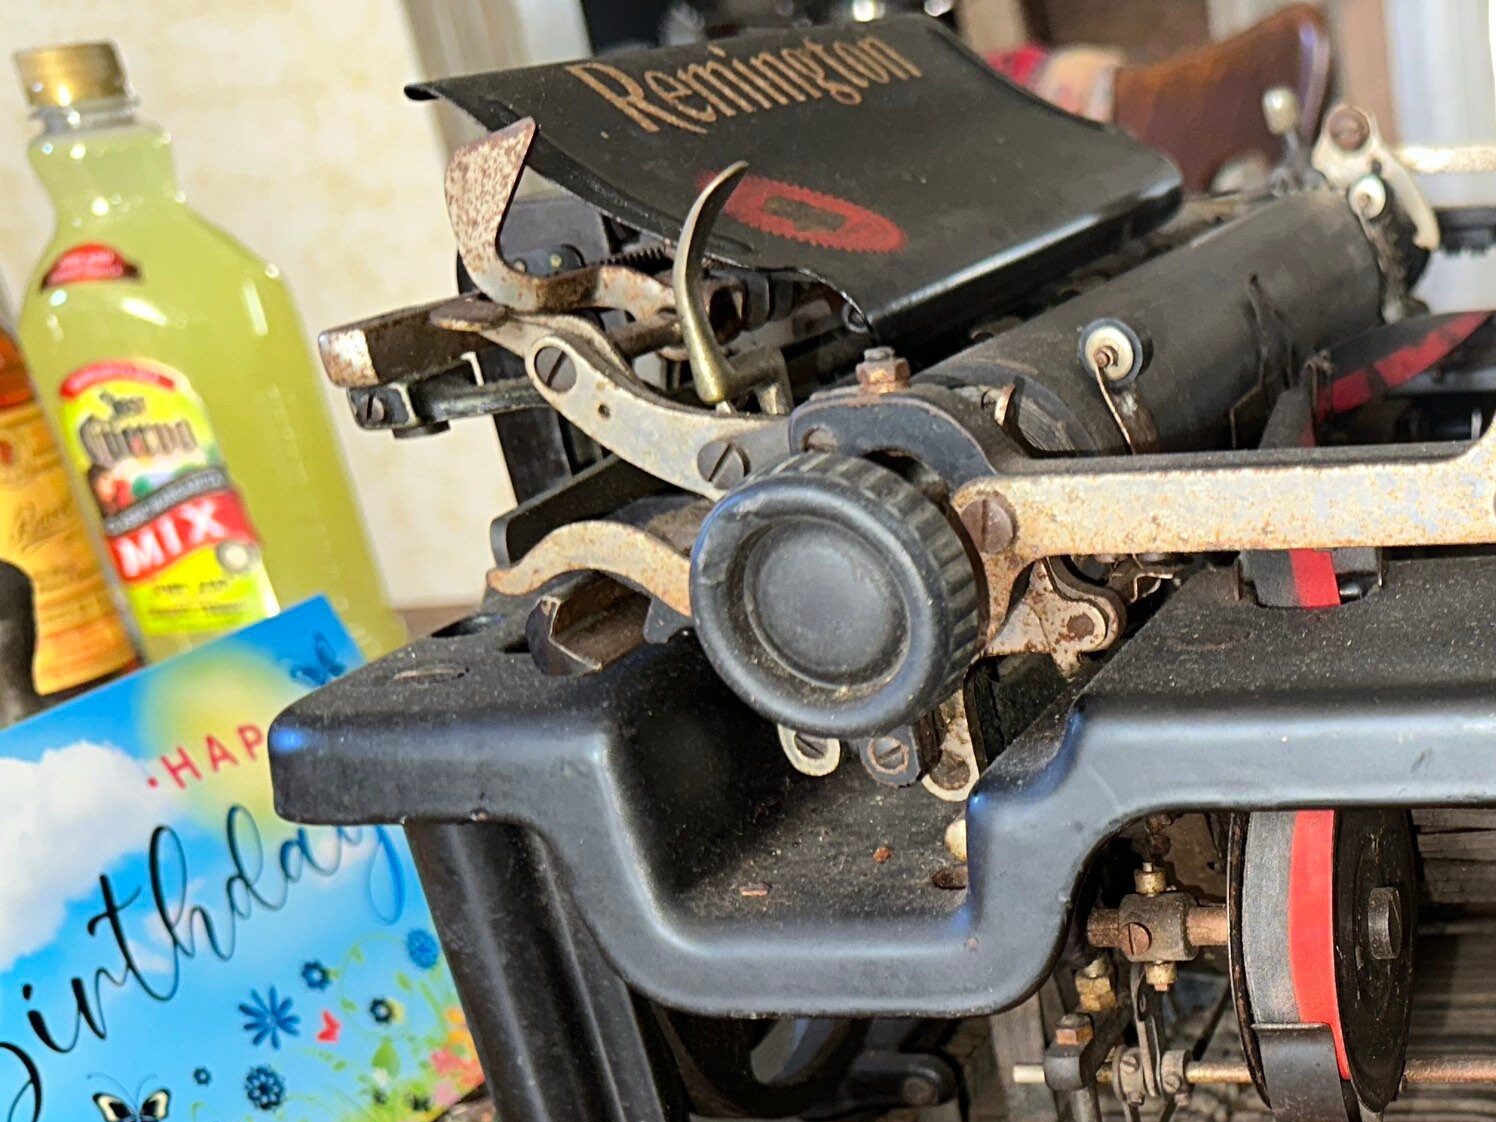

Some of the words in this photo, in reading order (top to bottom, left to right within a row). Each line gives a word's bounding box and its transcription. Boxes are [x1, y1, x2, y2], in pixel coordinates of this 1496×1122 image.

[565, 36, 923, 134] Remington
[115, 498, 228, 578] MIX
[159, 724, 264, 790] HAP
